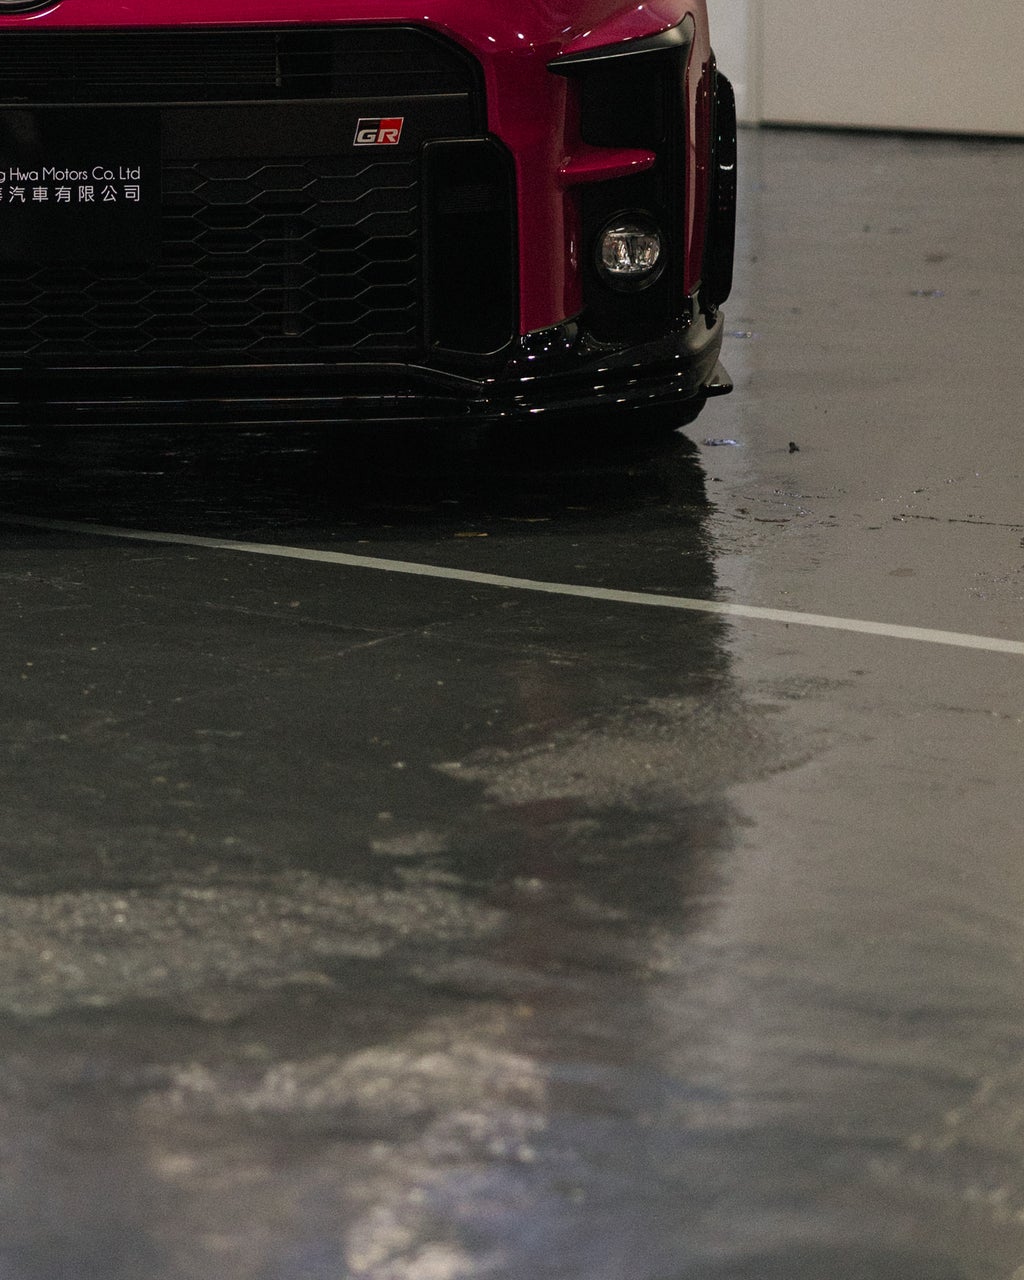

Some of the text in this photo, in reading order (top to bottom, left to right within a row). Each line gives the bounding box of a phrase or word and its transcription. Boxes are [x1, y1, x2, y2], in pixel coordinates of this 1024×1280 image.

[357, 128, 398, 143] GR
[9, 167, 39, 181] Hwa
[42, 167, 88, 181] Motors
[92, 166, 116, 180] Co.
[119, 165, 141, 180] Ltd
